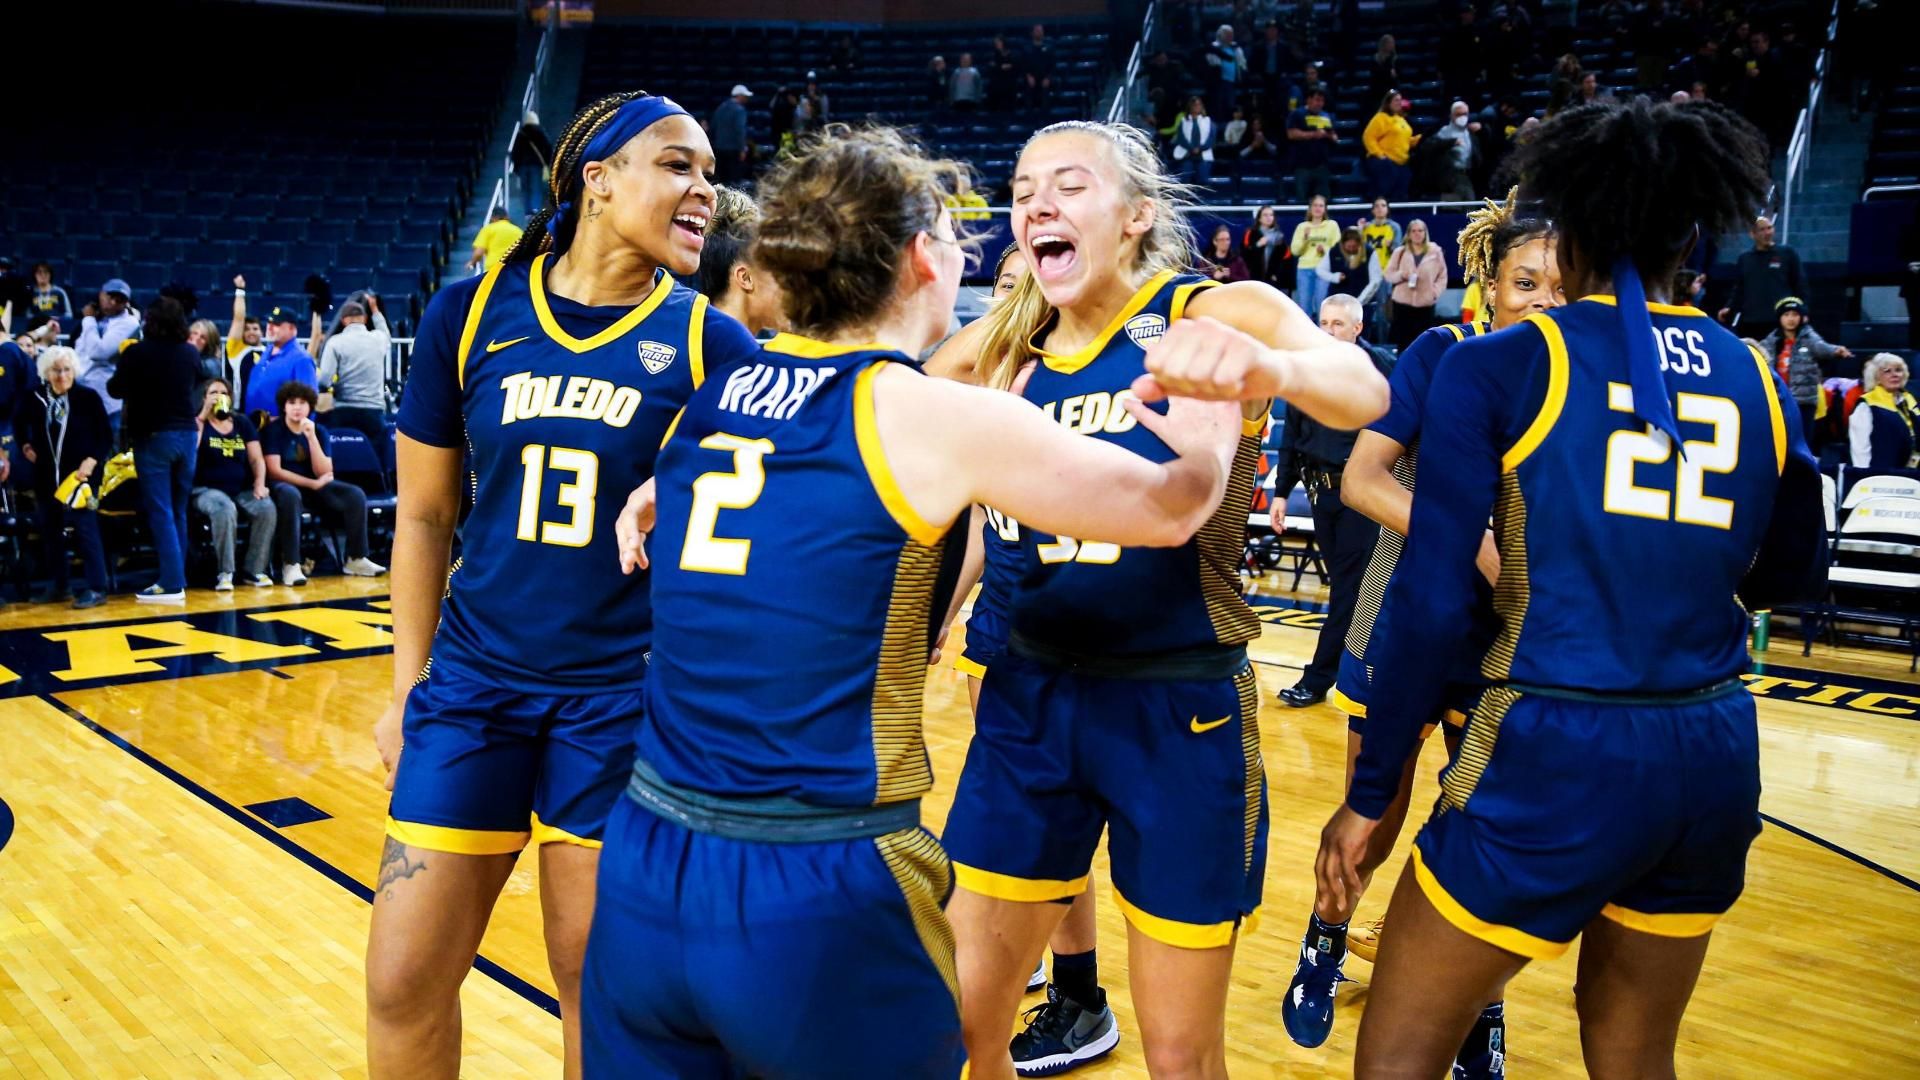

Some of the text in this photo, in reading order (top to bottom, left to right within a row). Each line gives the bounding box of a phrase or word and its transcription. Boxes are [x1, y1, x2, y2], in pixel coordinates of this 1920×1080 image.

[500, 371, 642, 428] TOLEDO
[1603, 381, 1741, 530] 22
[517, 444, 599, 547] 13
[679, 432, 776, 576] 2
